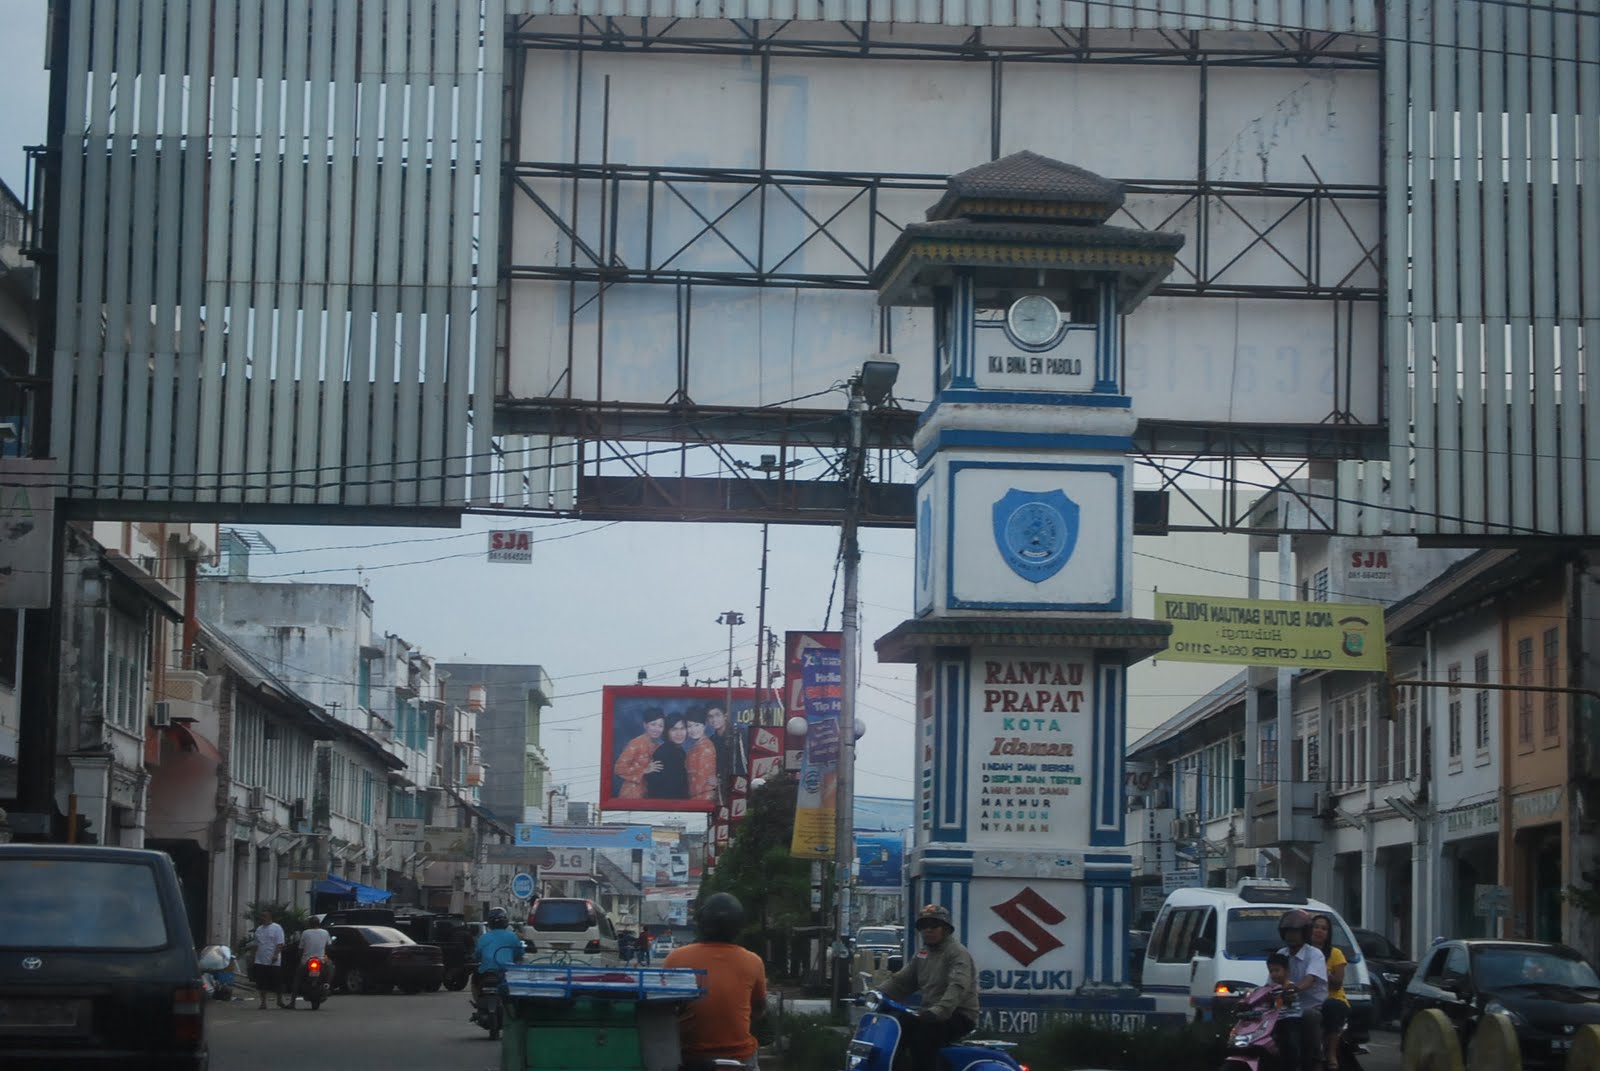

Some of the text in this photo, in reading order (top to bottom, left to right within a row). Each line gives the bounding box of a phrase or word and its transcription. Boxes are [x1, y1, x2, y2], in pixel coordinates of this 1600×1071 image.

[1030, 357, 1043, 375] EN
[1046, 358, 1082, 376] PABOLO
[491, 532, 529, 551] SJA
[1351, 551, 1388, 569] SJA
[984, 661, 1084, 686] RANTAU
[983, 689, 1084, 713] PRAPAT
[1003, 717, 1061, 731] KOTA
[990, 737, 1074, 757] Idaman
[982, 762, 1013, 772] INDAH
[1017, 763, 1036, 772] DAN
[1026, 775, 1045, 785] DAN
[1015, 786, 1035, 796] DAN
[981, 798, 1051, 808] MAKMUR
[981, 823, 1049, 833] NYAMAN
[559, 853, 583, 869] LG
[978, 969, 1072, 991] SUZUKI
[999, 1011, 1038, 1033] EXPO
